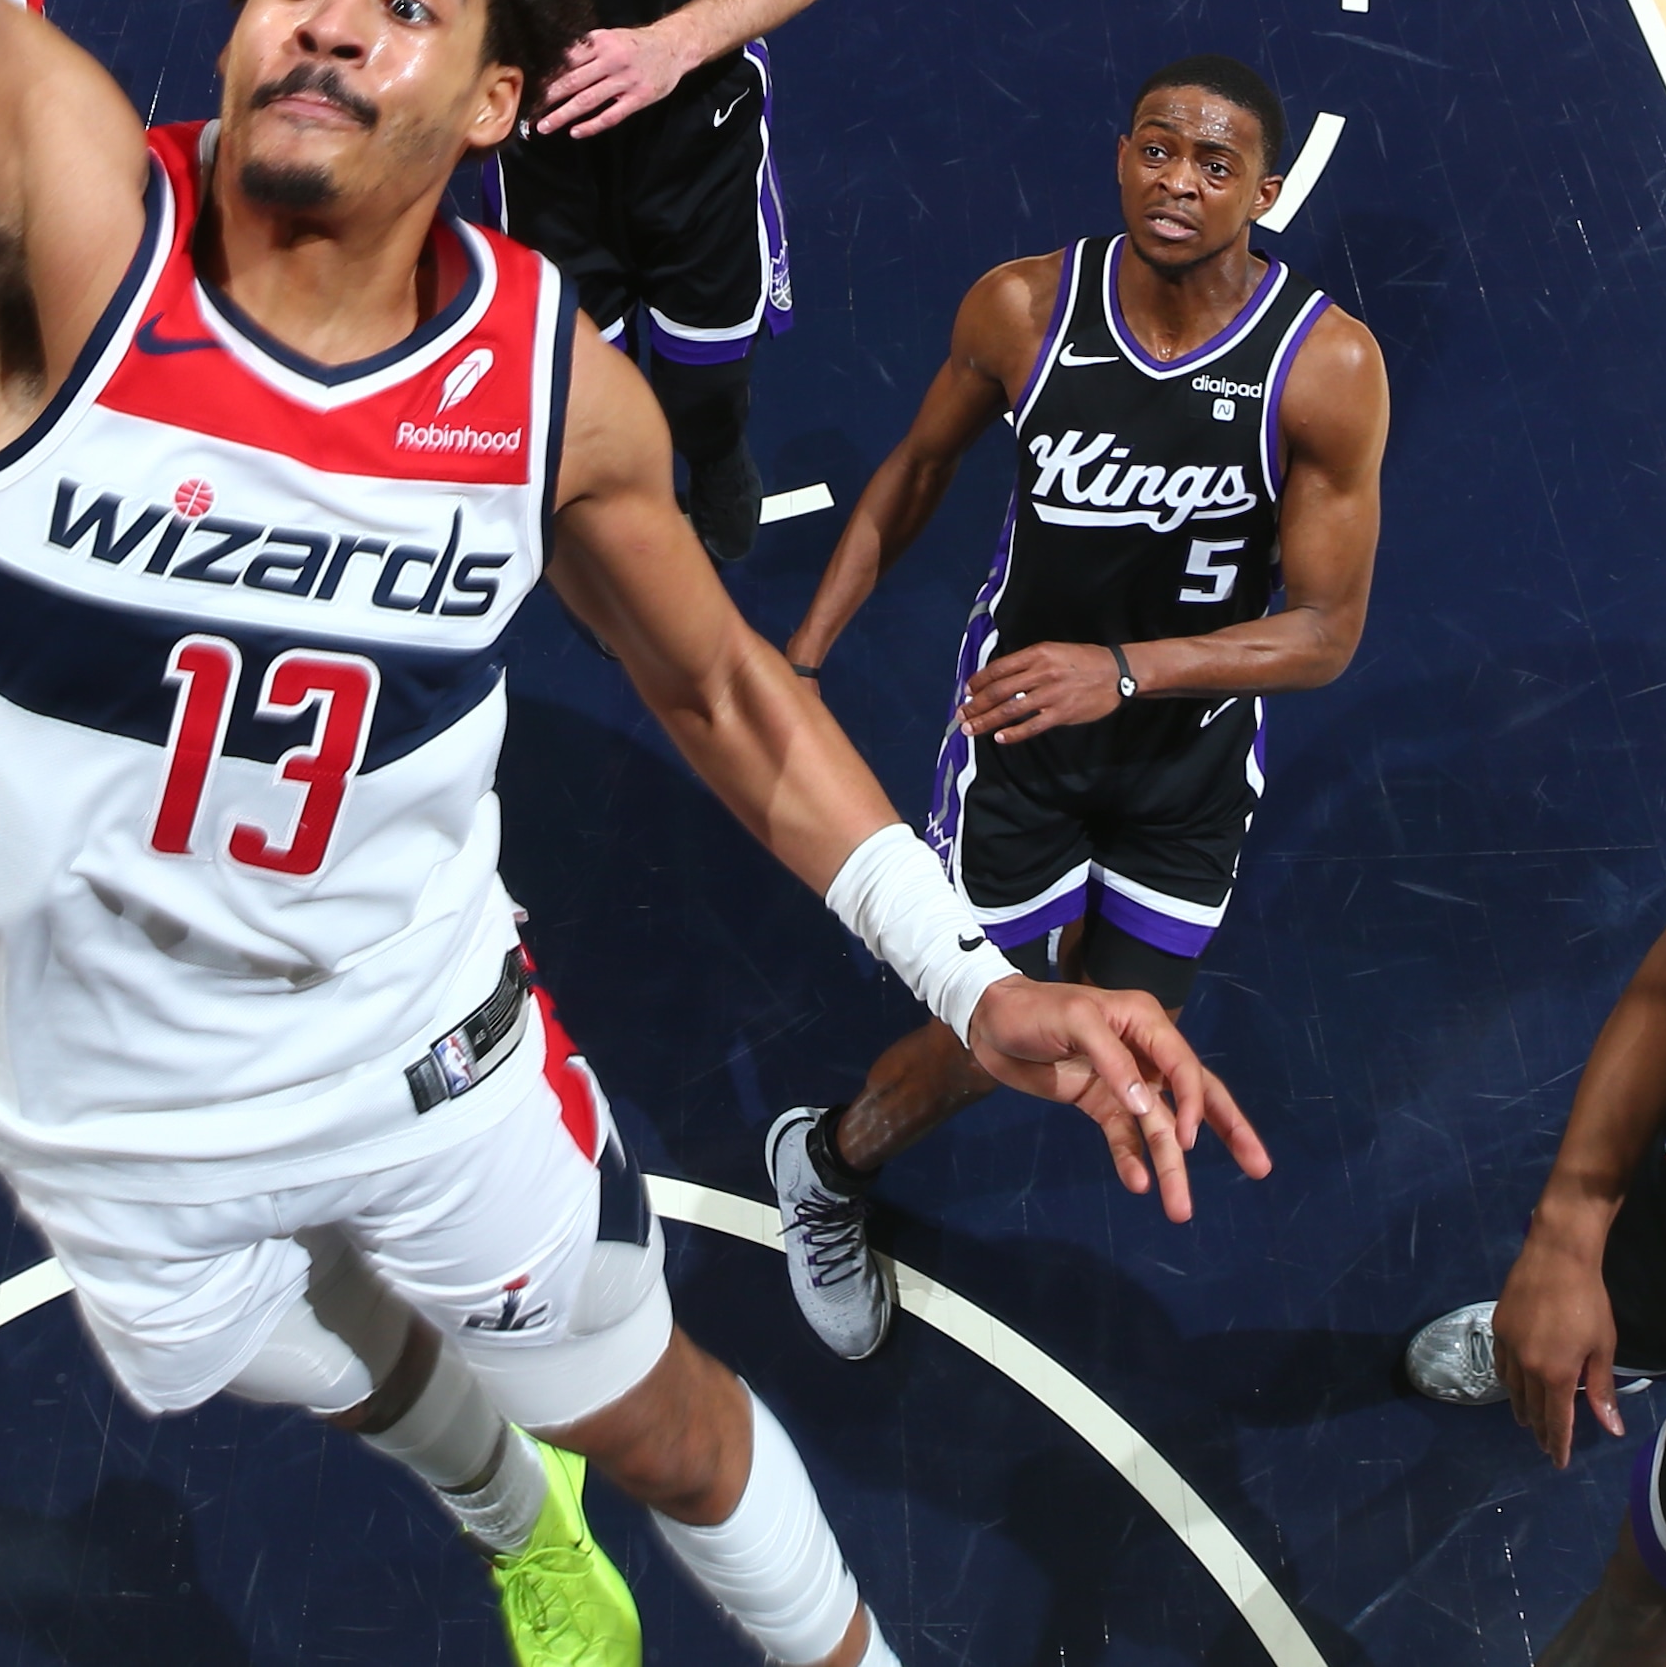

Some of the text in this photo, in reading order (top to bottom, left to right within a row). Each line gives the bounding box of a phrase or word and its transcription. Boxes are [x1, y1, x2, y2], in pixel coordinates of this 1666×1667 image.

[1191, 374, 1263, 400] dialpad
[396, 420, 523, 453] Robinhood
[1028, 429, 1257, 533] Kings
[1178, 537, 1248, 603] 5
[149, 634, 381, 876] 13
